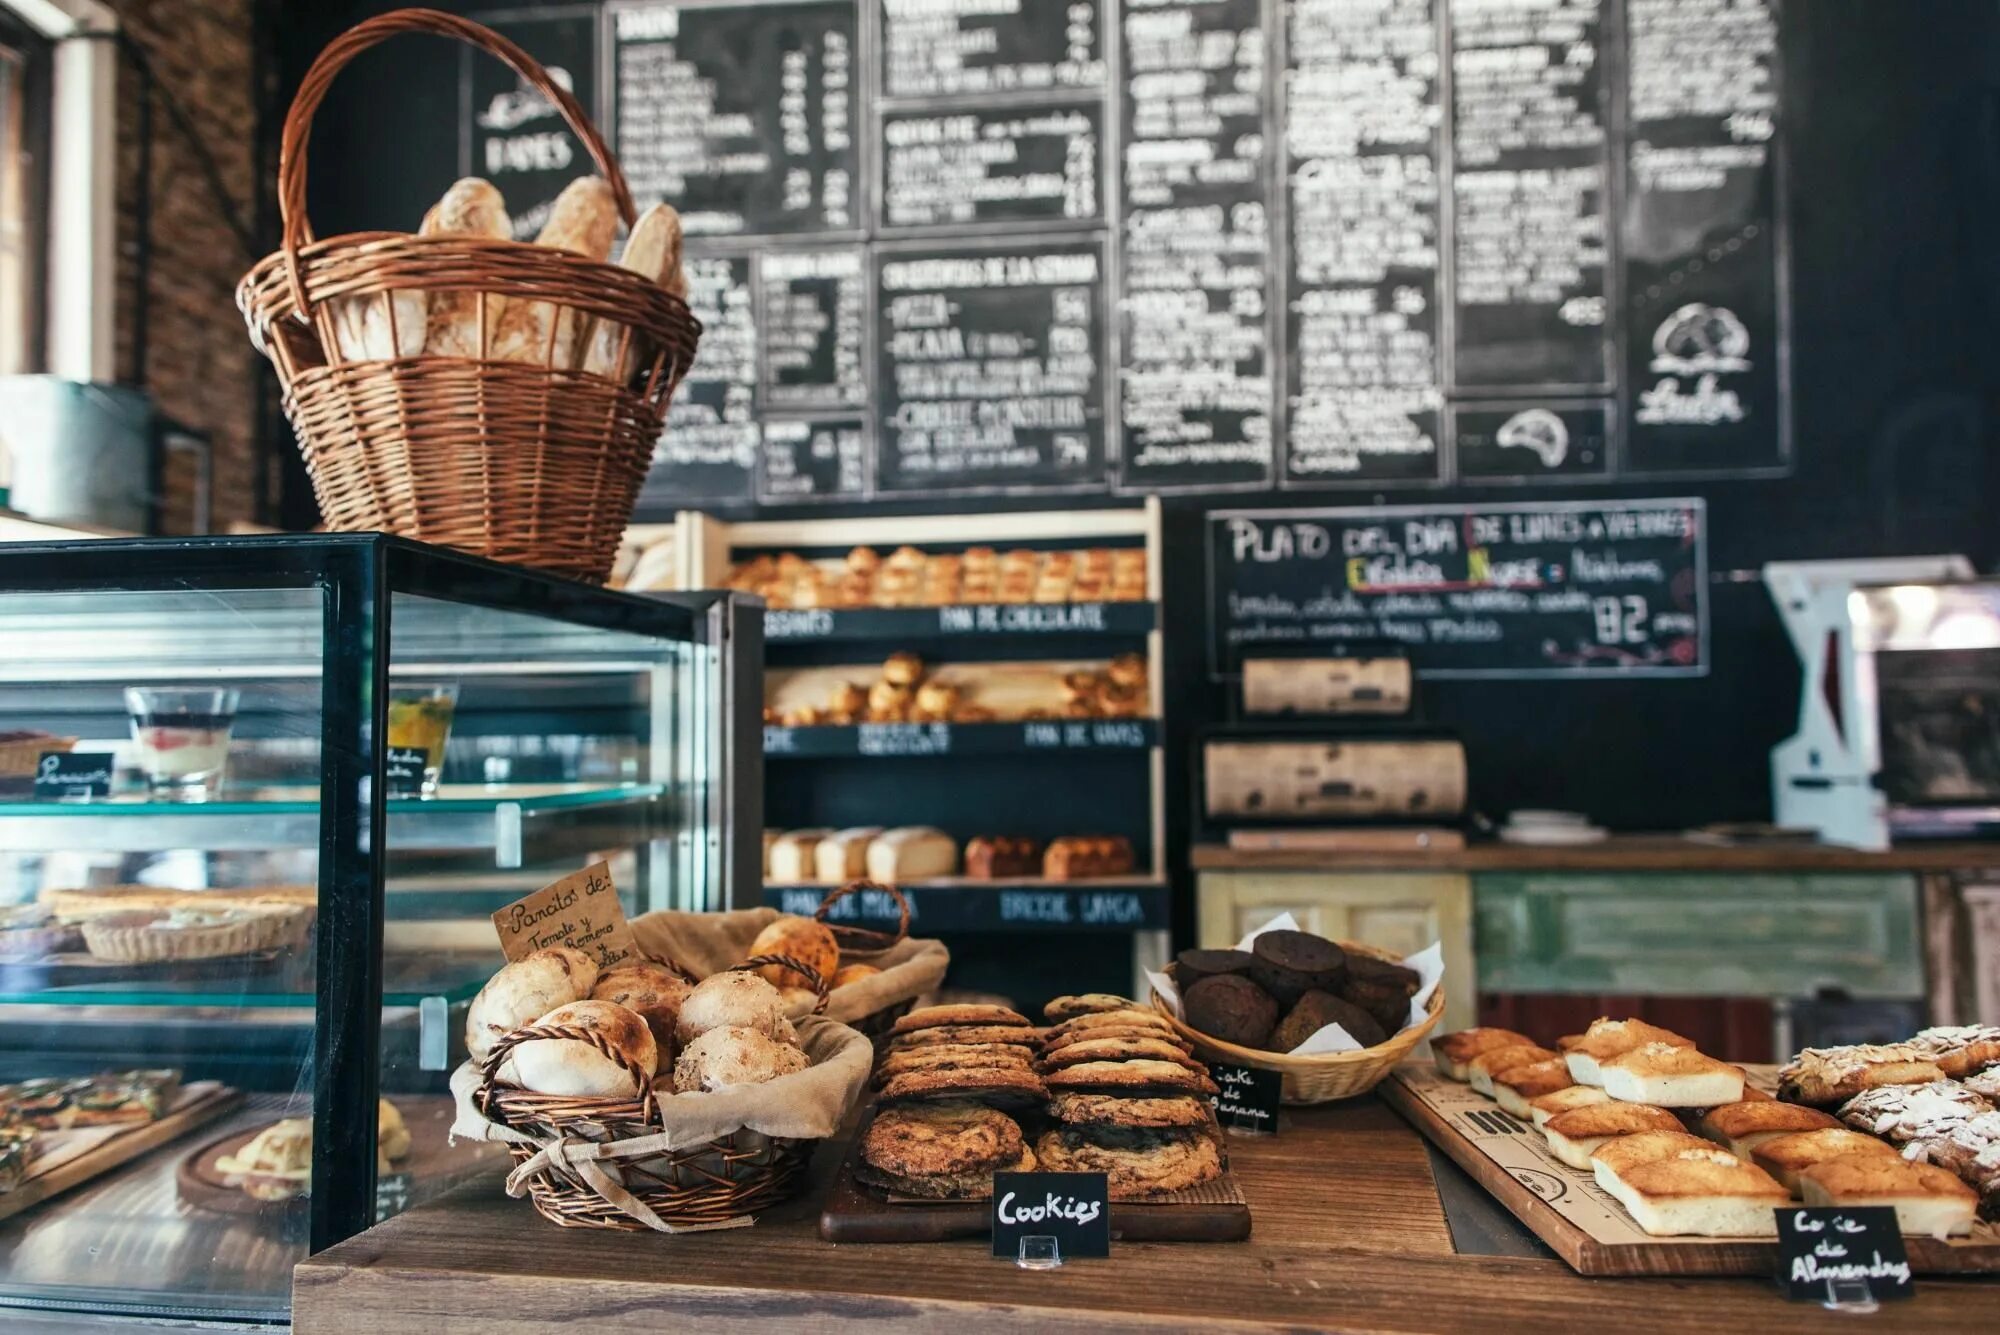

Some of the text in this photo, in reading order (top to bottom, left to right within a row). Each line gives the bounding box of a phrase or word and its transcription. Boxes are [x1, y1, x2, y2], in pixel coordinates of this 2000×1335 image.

[1226, 517, 1331, 562] PLATO
[511, 888, 579, 934] Pancitos
[528, 916, 593, 951] Tomate y
[564, 923, 614, 950] Romero
[1223, 1085, 1241, 1099] de
[998, 1191, 1101, 1226] Cookies
[1814, 1238, 1849, 1257] de
